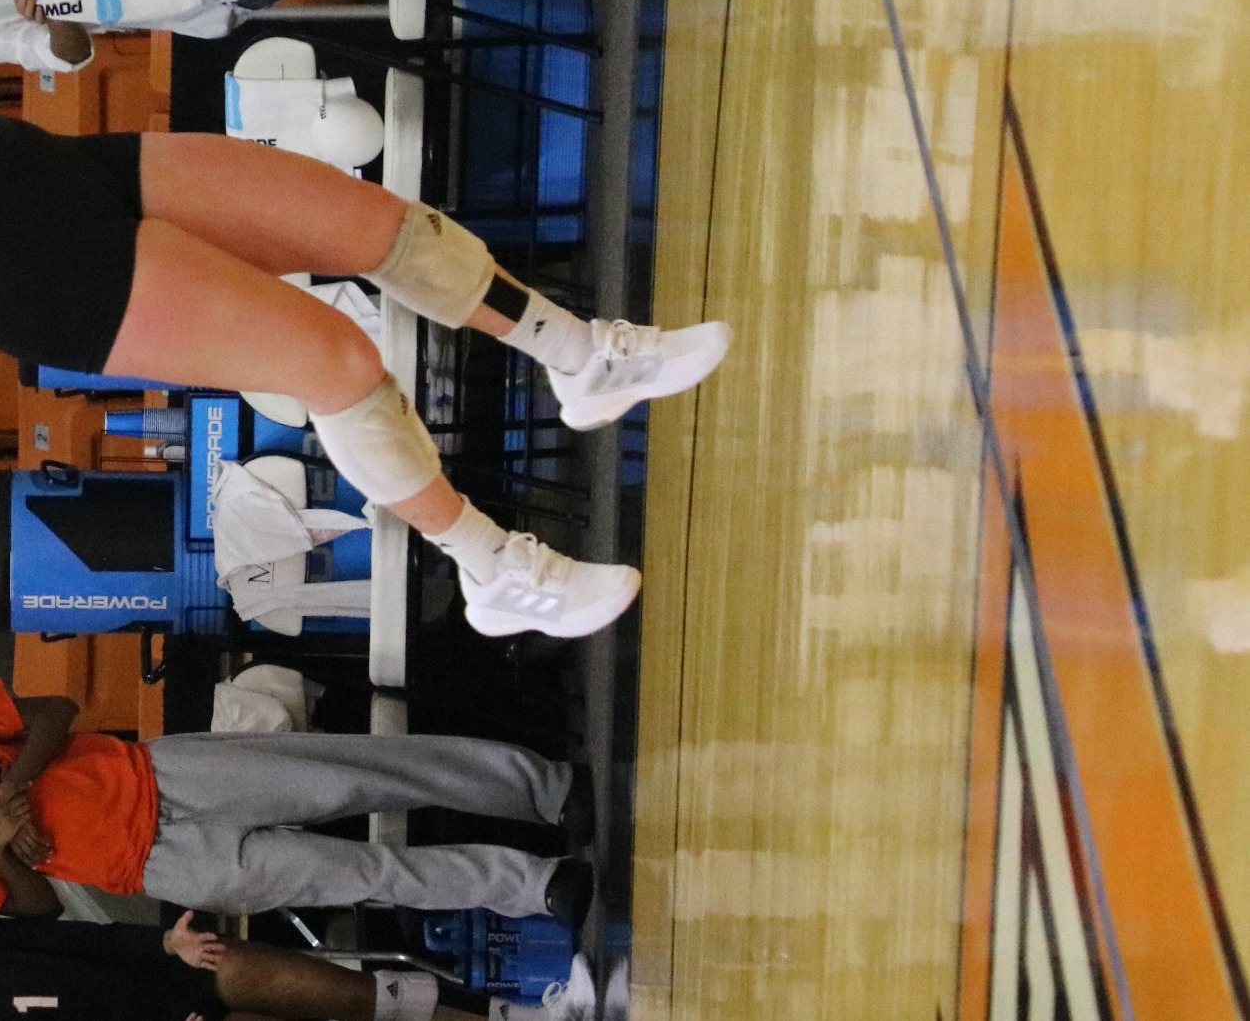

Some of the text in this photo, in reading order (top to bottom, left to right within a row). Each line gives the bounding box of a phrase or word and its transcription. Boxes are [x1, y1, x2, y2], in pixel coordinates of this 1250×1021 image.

[36, 0, 83, 16] POW
[21, 595, 168, 609] POWERADE
[12, 996, 59, 1013] 1
